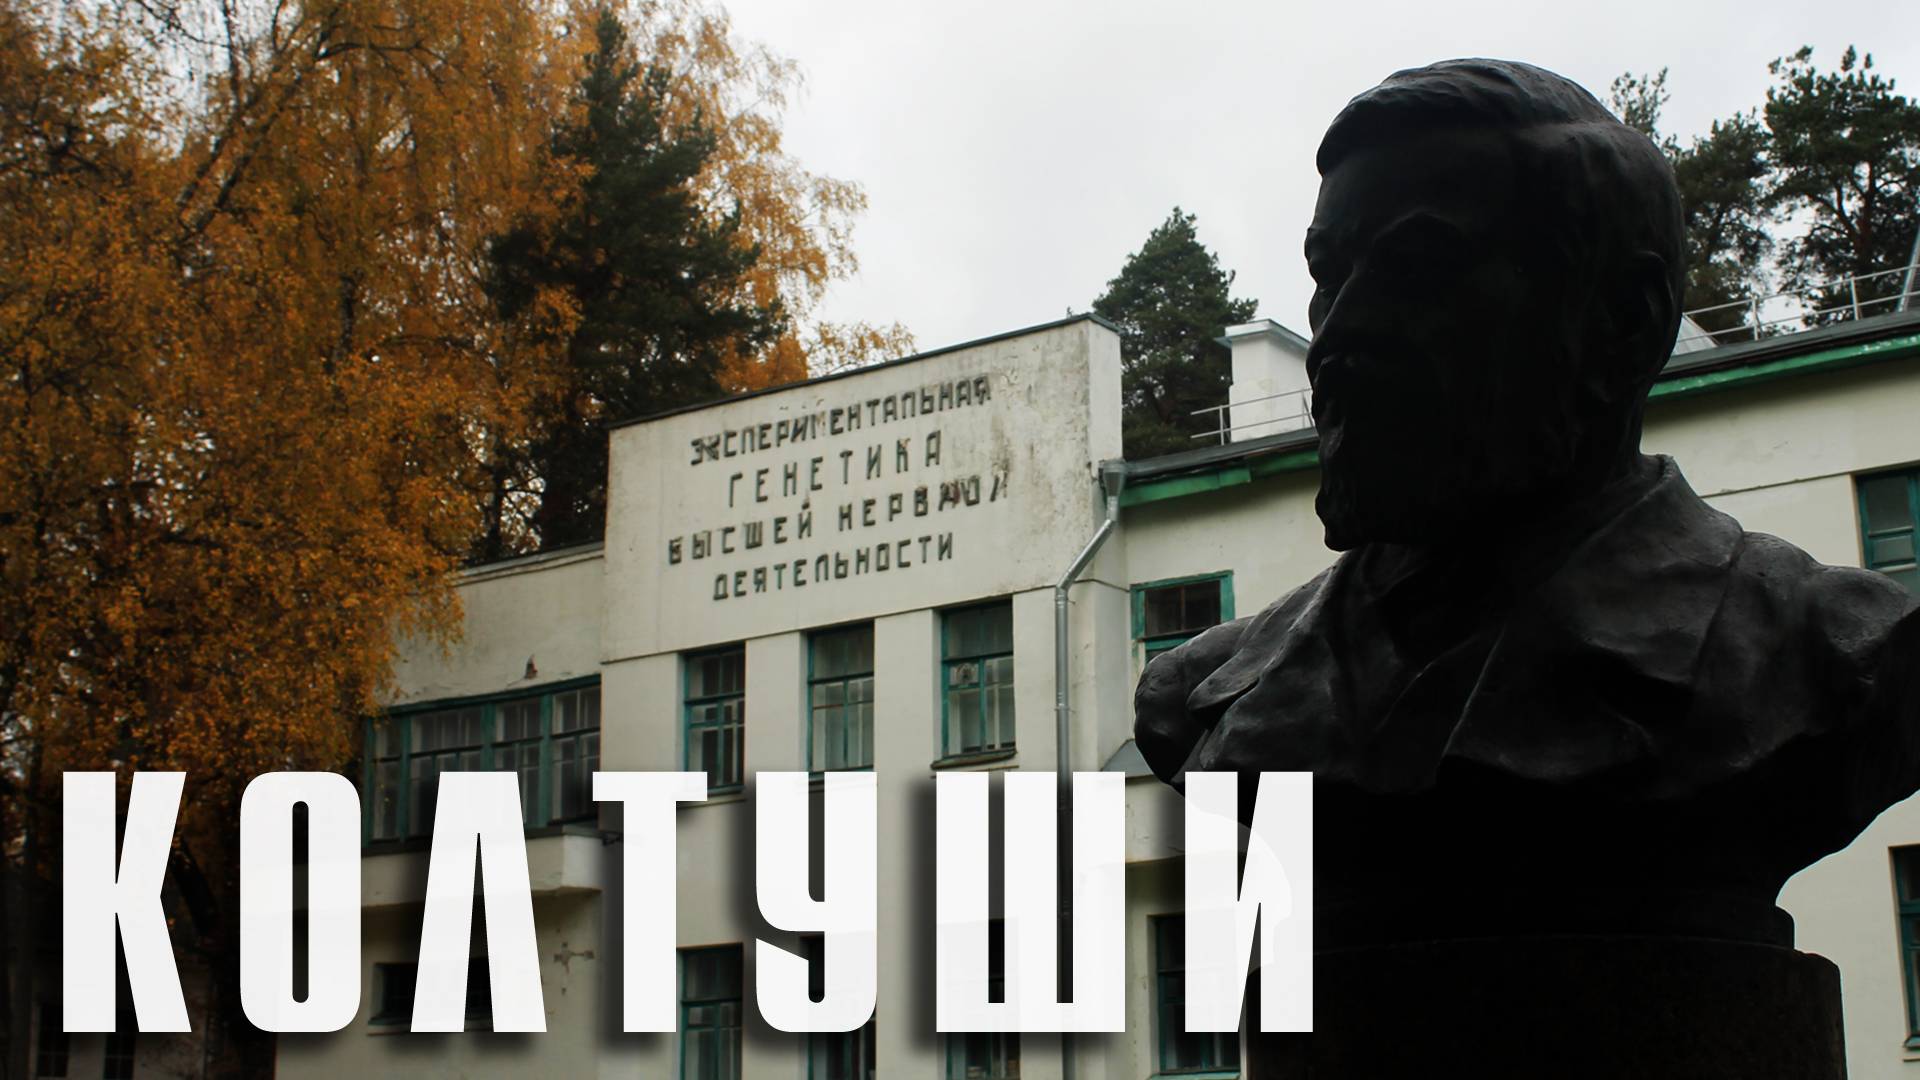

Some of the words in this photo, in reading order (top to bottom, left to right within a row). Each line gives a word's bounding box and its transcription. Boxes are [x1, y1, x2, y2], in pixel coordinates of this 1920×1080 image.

[729, 430, 942, 508] ГЕНЕТИКА
[669, 501, 812, 565] ВЫСШЕЙ
[713, 532, 953, 601] ДЕЯТЕЛЬНОСТИ
